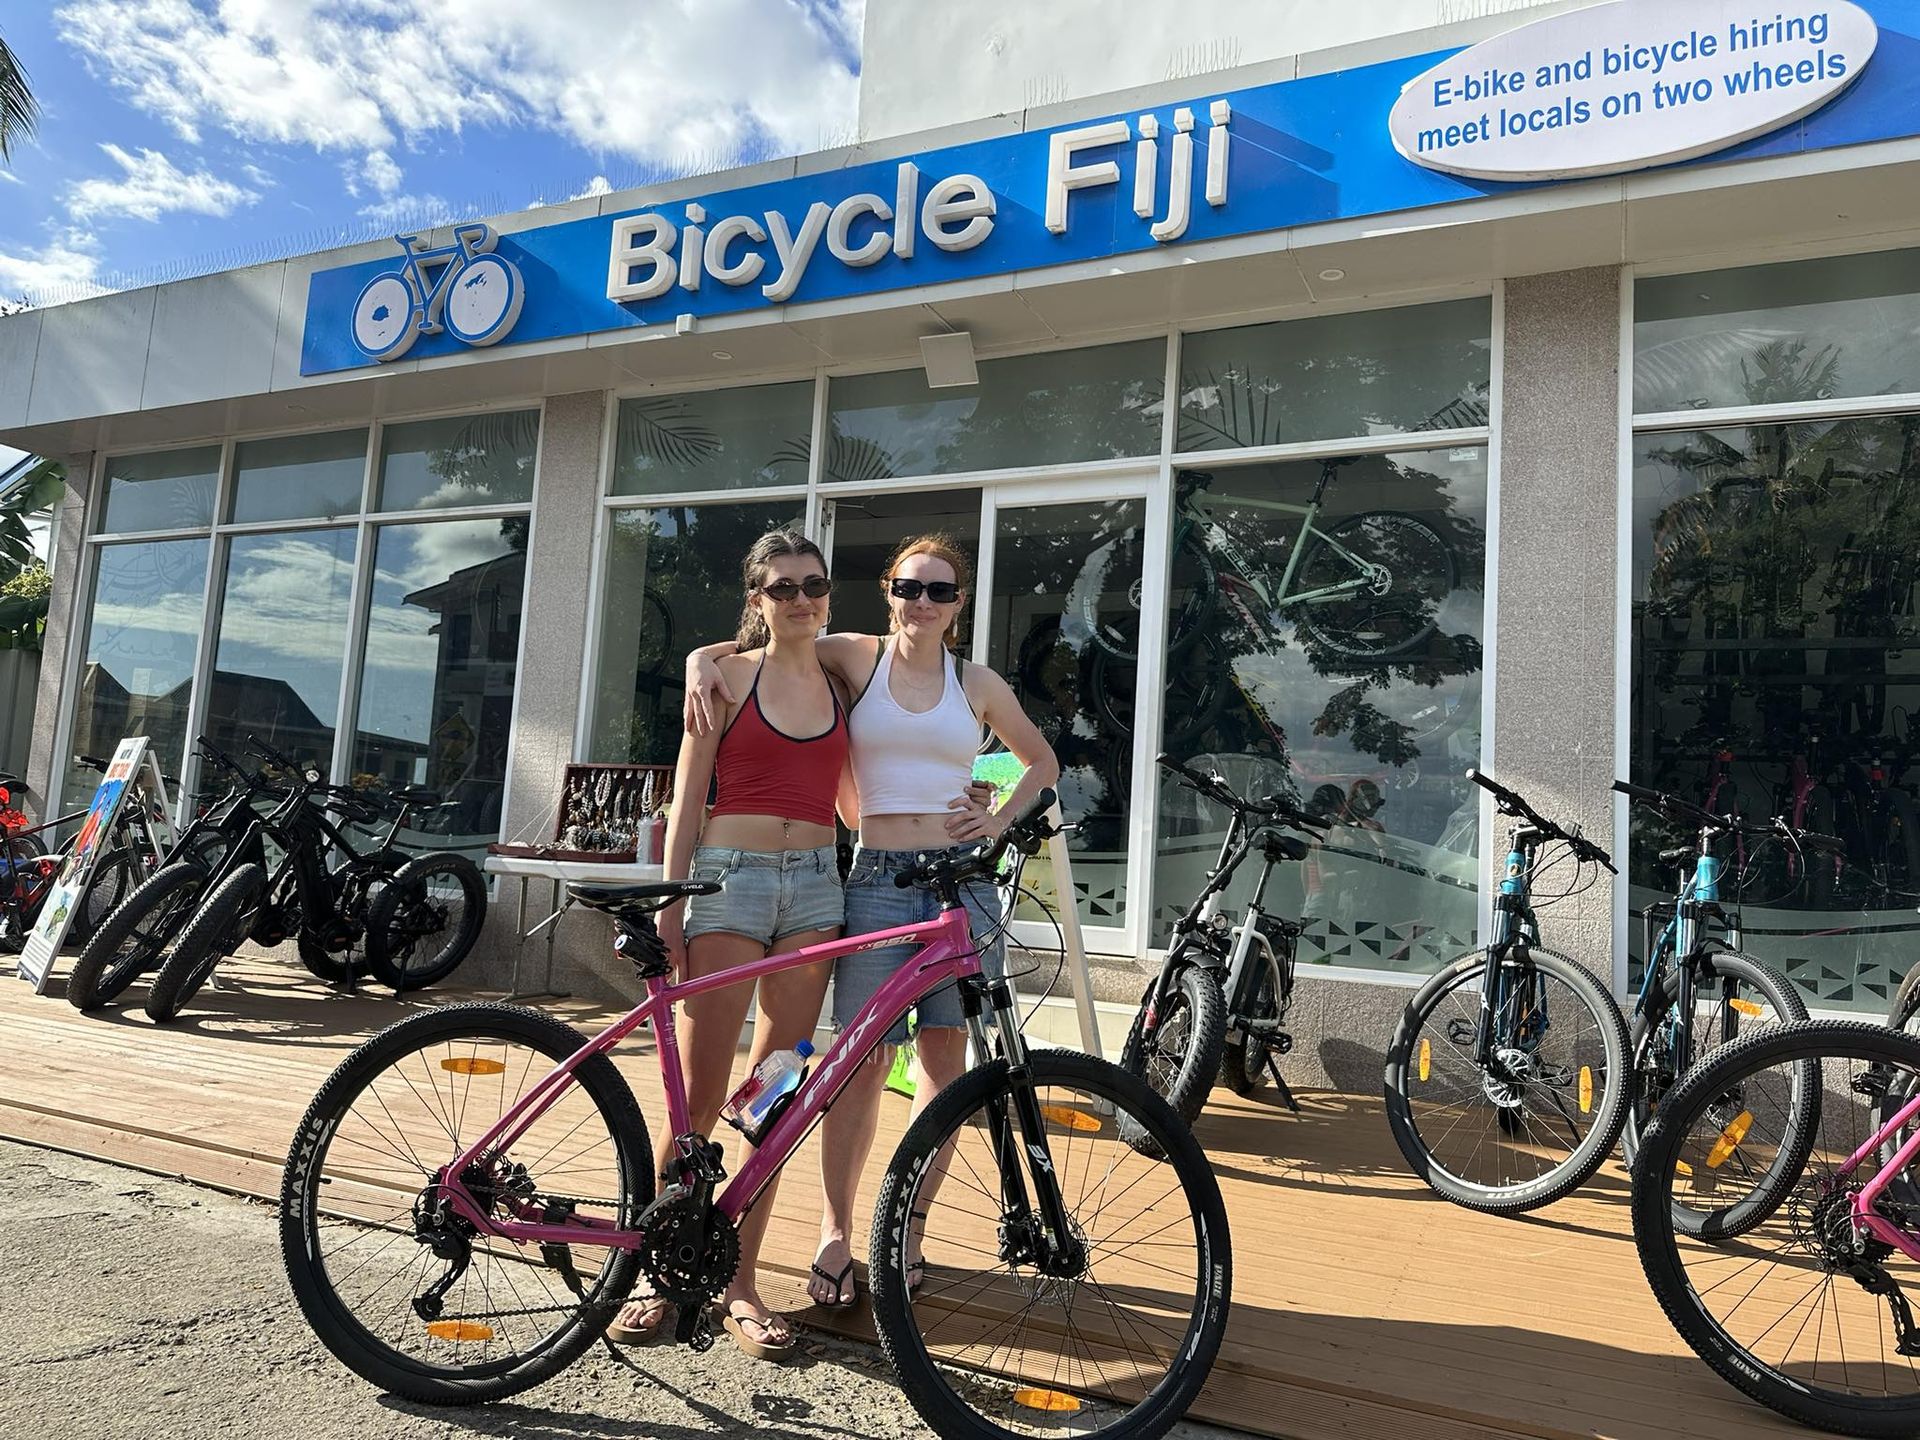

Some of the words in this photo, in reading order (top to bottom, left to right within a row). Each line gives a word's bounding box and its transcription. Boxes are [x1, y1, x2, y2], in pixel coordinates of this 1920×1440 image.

[1417, 113, 1490, 153] meet
[1499, 96, 1591, 138] locals
[1601, 90, 1642, 119] on
[1652, 78, 1713, 109] two
[1722, 49, 1847, 97] wheels
[1433, 69, 1526, 108] E-bike
[1534, 50, 1592, 88] and
[1602, 30, 1718, 75] bicycle
[1729, 12, 1829, 52] hiring
[606, 162, 997, 303] Bicycle
[1045, 99, 1232, 243] Fiji
[289, 1117, 324, 1219] MAXXIS
[890, 1156, 922, 1269] MAXXIS
